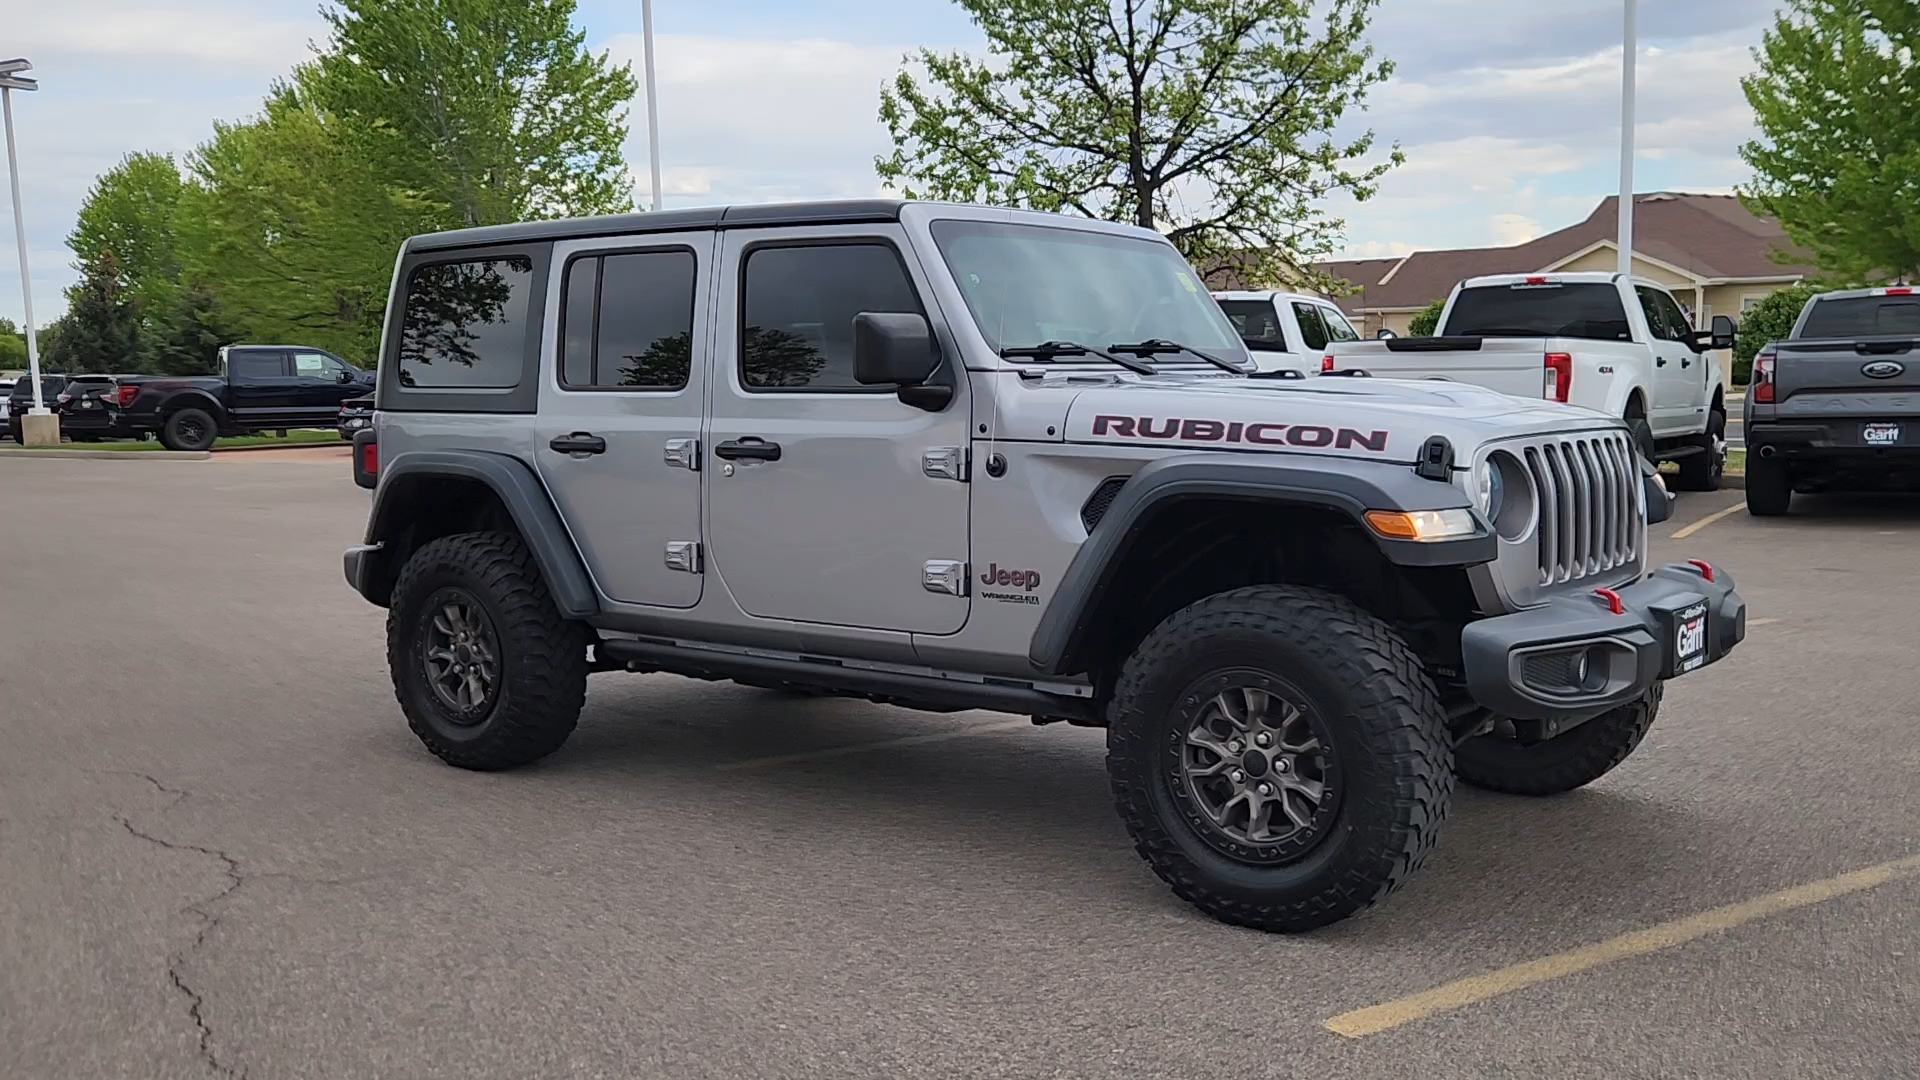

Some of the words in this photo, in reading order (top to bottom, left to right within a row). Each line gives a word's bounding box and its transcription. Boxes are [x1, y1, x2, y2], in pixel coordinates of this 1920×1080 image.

[1092, 415, 1388, 452] RUBICON
[980, 562, 1040, 592] Jeep
[1676, 616, 1704, 658] Garff
